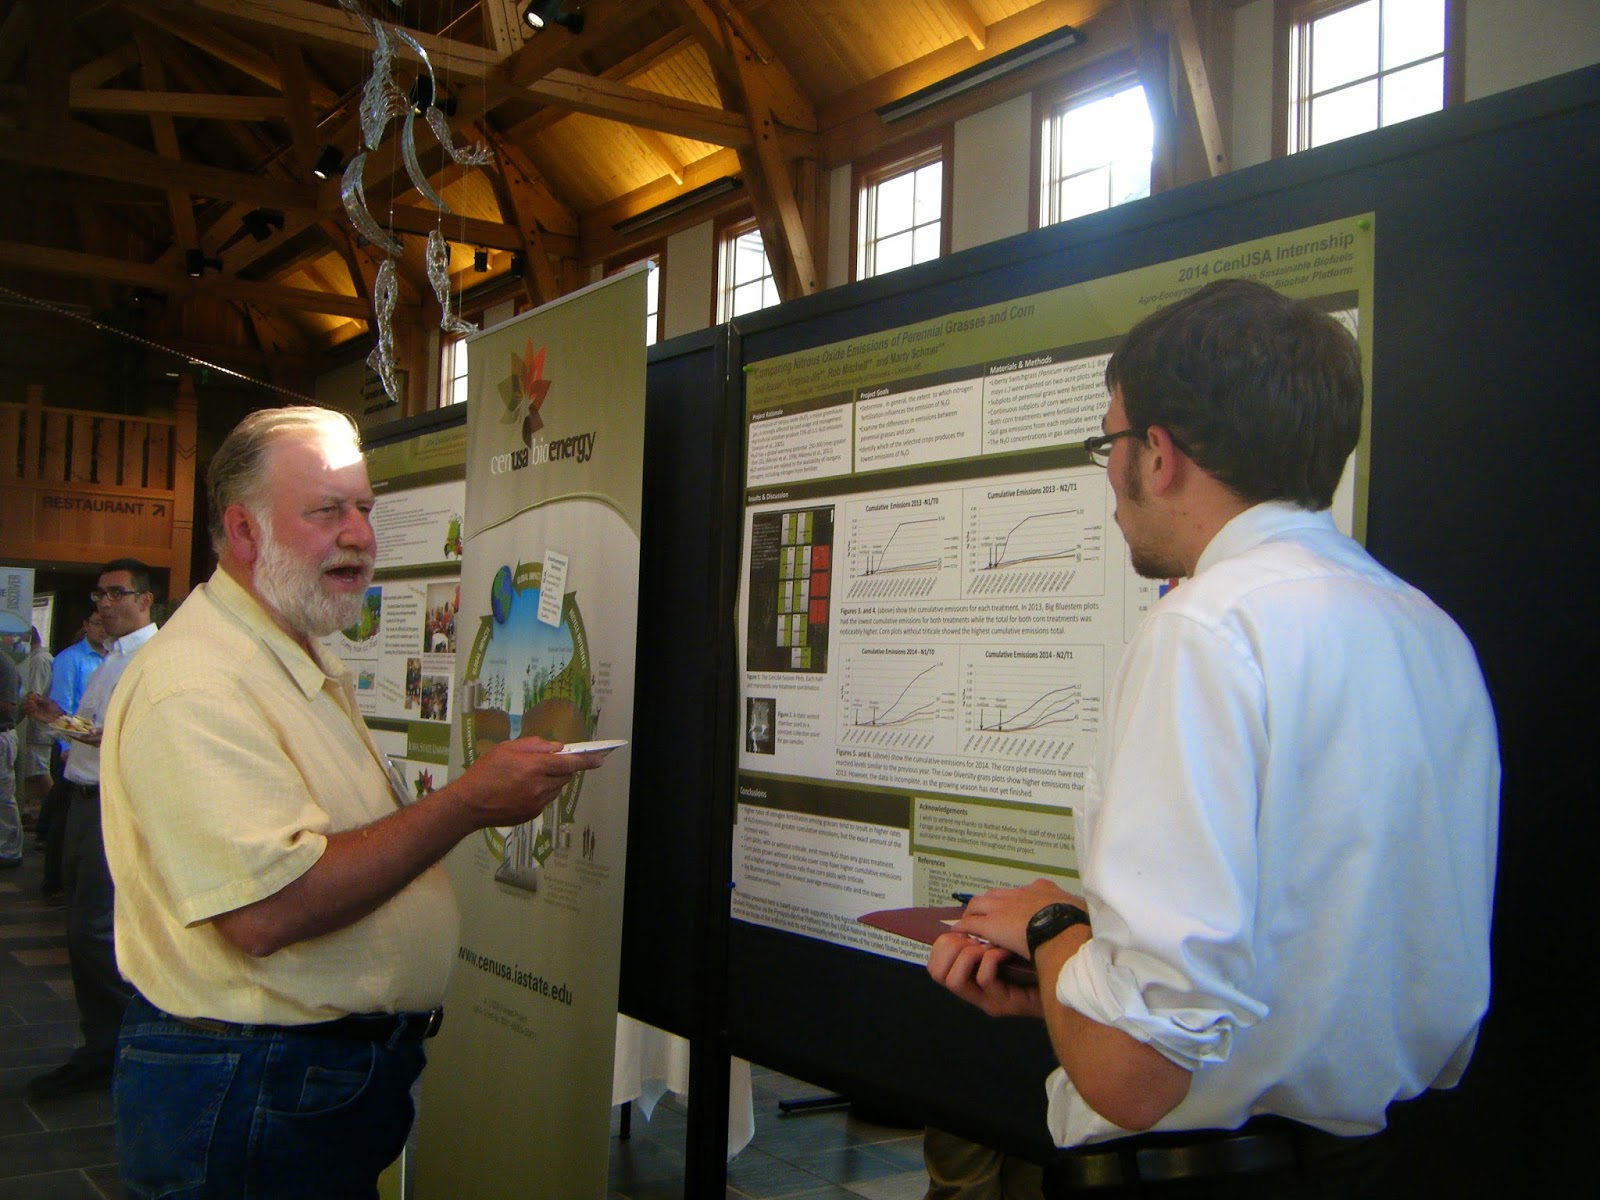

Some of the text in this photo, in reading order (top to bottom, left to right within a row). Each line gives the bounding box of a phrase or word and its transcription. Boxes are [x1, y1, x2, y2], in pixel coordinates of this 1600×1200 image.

[1178, 232, 1354, 283] 2014 CenUSA Internship
[1260, 261, 1311, 279] Sustainable
[1314, 252, 1353, 267] Biofuels
[1312, 266, 1352, 281] Platform
[794, 355, 820, 370] Nitrous
[823, 350, 844, 363] Oxide
[847, 341, 888, 357] Emissions
[891, 333, 900, 346] of
[902, 327, 942, 344] Perennial
[946, 317, 985, 333] Grasses
[988, 308, 1006, 321] and
[1010, 304, 1035, 319] Corn
[990, 362, 1017, 374] Materials
[1025, 355, 1052, 367] Methods
[532, 432, 596, 465] bioenergy
[988, 490, 1015, 499] Cumulative
[1016, 488, 1041, 496] Emissions
[1060, 484, 1077, 493] N2/T1
[42, 496, 144, 515] RESTAURANT
[1056, 652, 1073, 660] N2/T1
[920, 803, 968, 816] Acknowledgements
[918, 856, 946, 868] References
